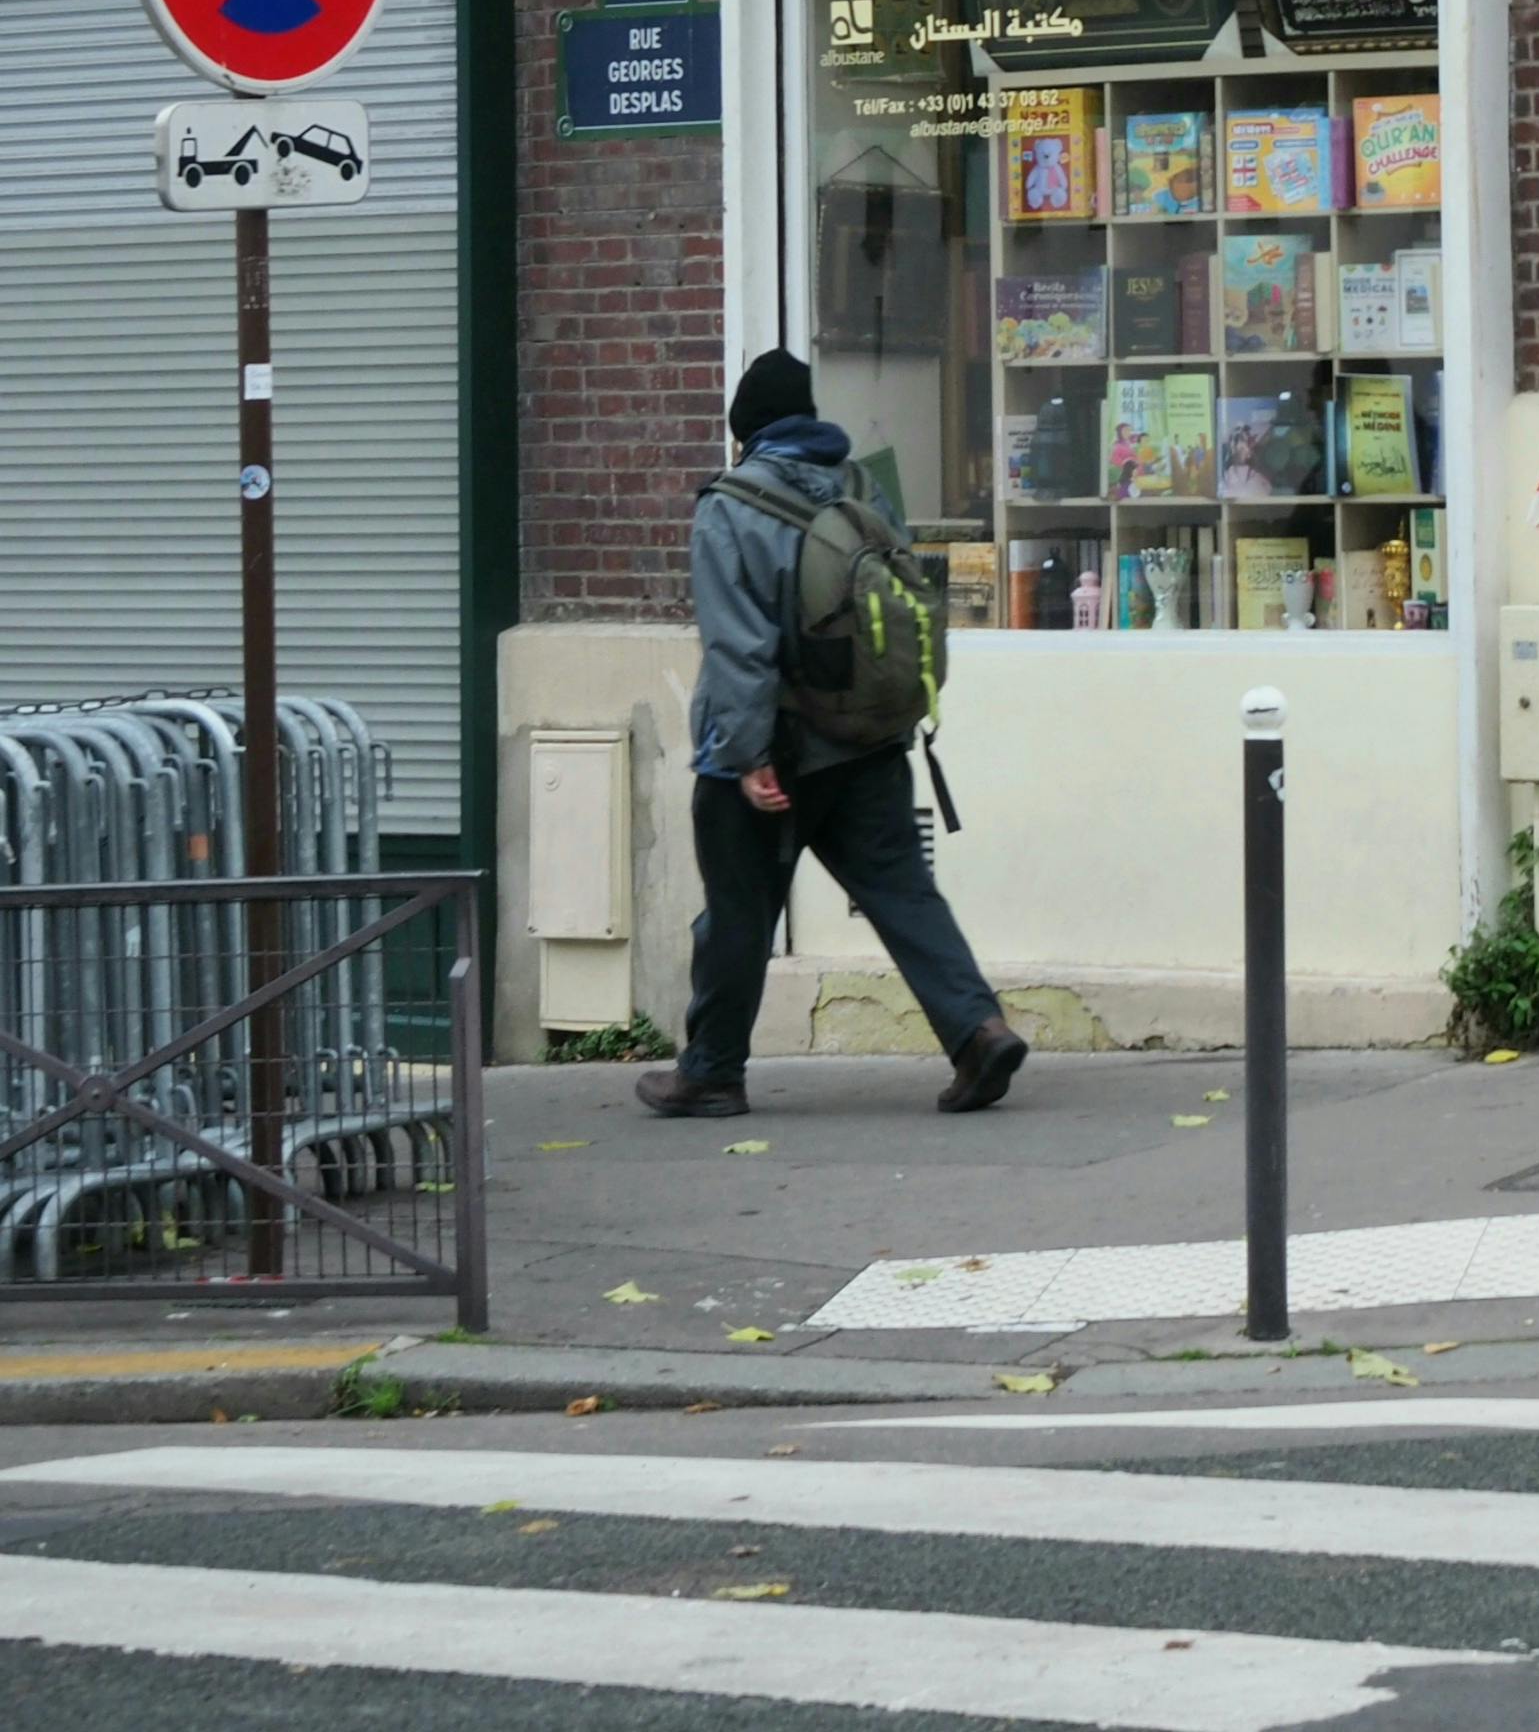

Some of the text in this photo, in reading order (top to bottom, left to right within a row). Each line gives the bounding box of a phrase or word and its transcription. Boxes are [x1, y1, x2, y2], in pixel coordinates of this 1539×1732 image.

[629, 27, 662, 50] RUE
[909, 6, 1083, 50] مكتبة البستان
[607, 58, 684, 83] GEORGES
[819, 49, 885, 68] albustane
[609, 90, 683, 115] DESPLAS
[917, 95, 944, 113] +33
[947, 93, 974, 115] (0)1
[977, 92, 995, 109] 43
[1000, 91, 1017, 107] 37
[1019, 90, 1037, 106] 08
[1041, 89, 1059, 105] 62
[909, 115, 1058, 138] albustane@orange.fr
[1367, 145, 1440, 176] CHALLENGE
